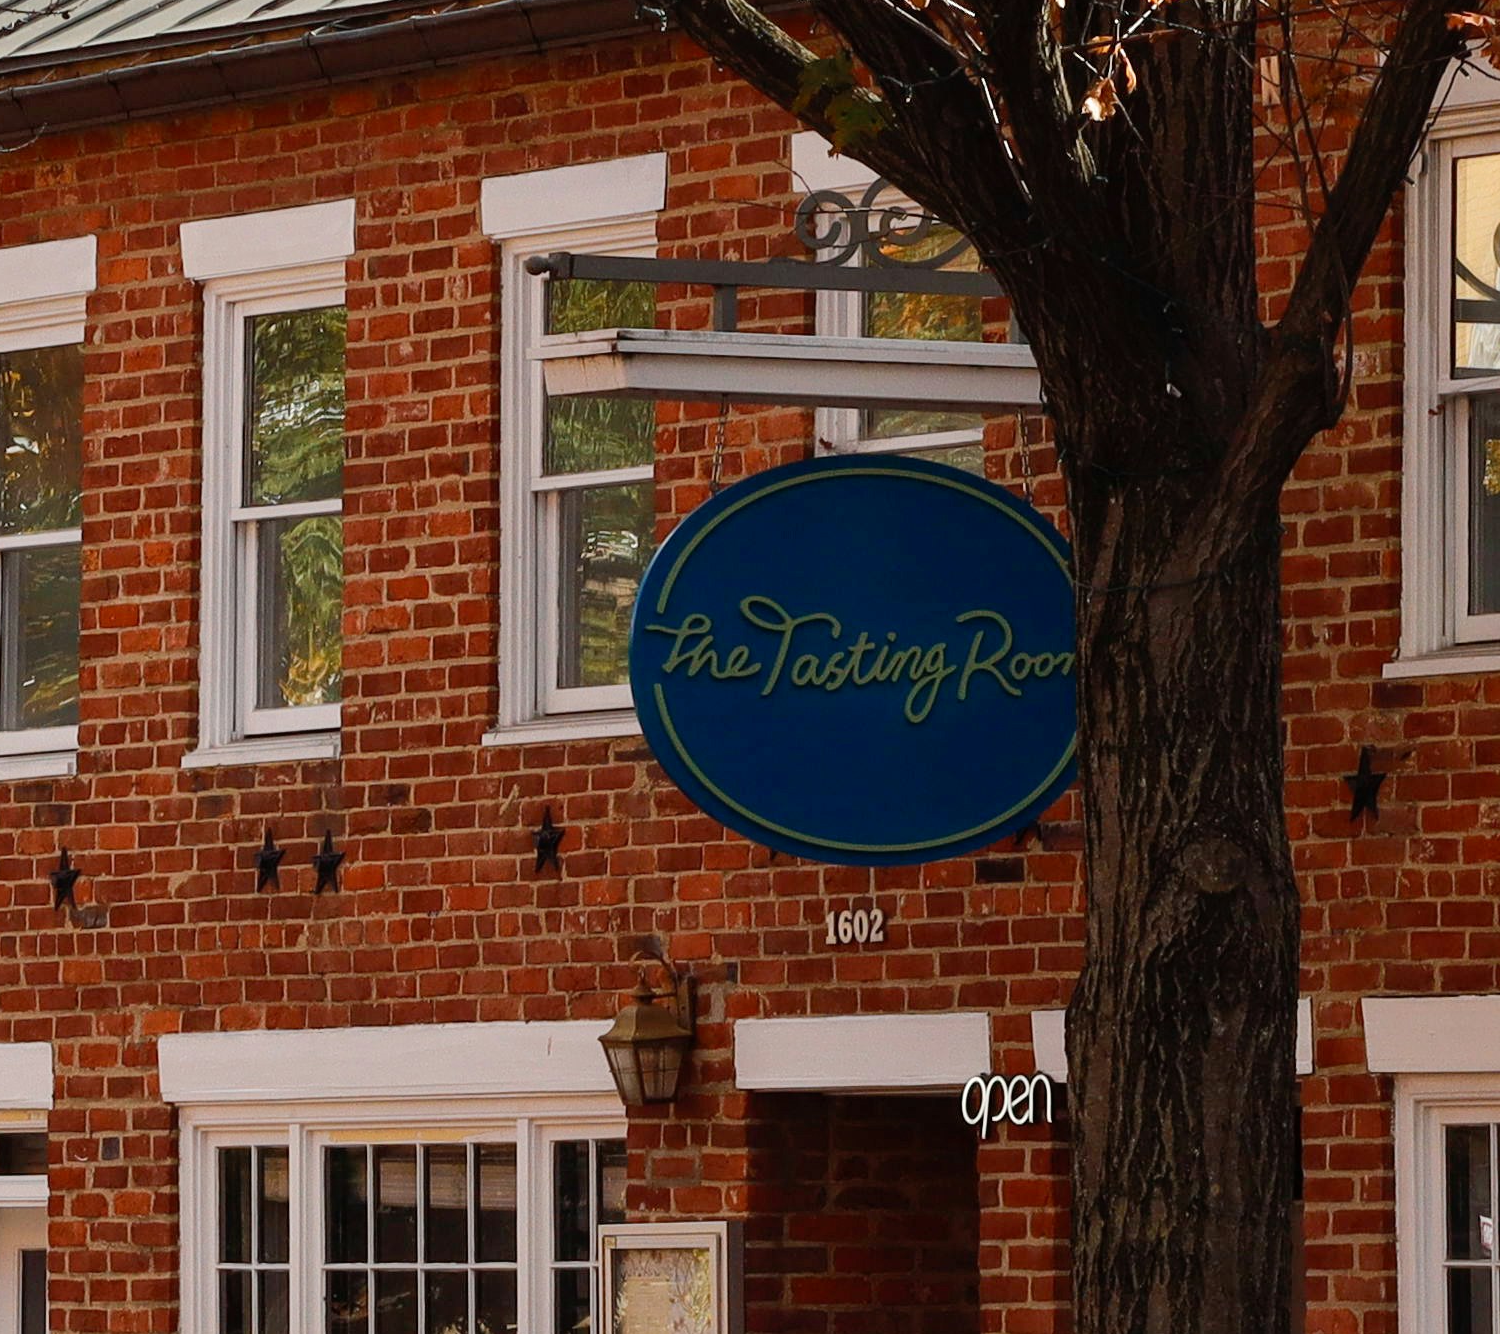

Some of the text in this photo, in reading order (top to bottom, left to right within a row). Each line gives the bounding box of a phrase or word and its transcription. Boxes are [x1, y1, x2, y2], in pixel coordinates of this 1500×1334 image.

[646, 613, 762, 678] The
[740, 595, 958, 724] Tasting
[825, 908, 885, 945] 1602
[961, 1074, 1053, 1140] open
